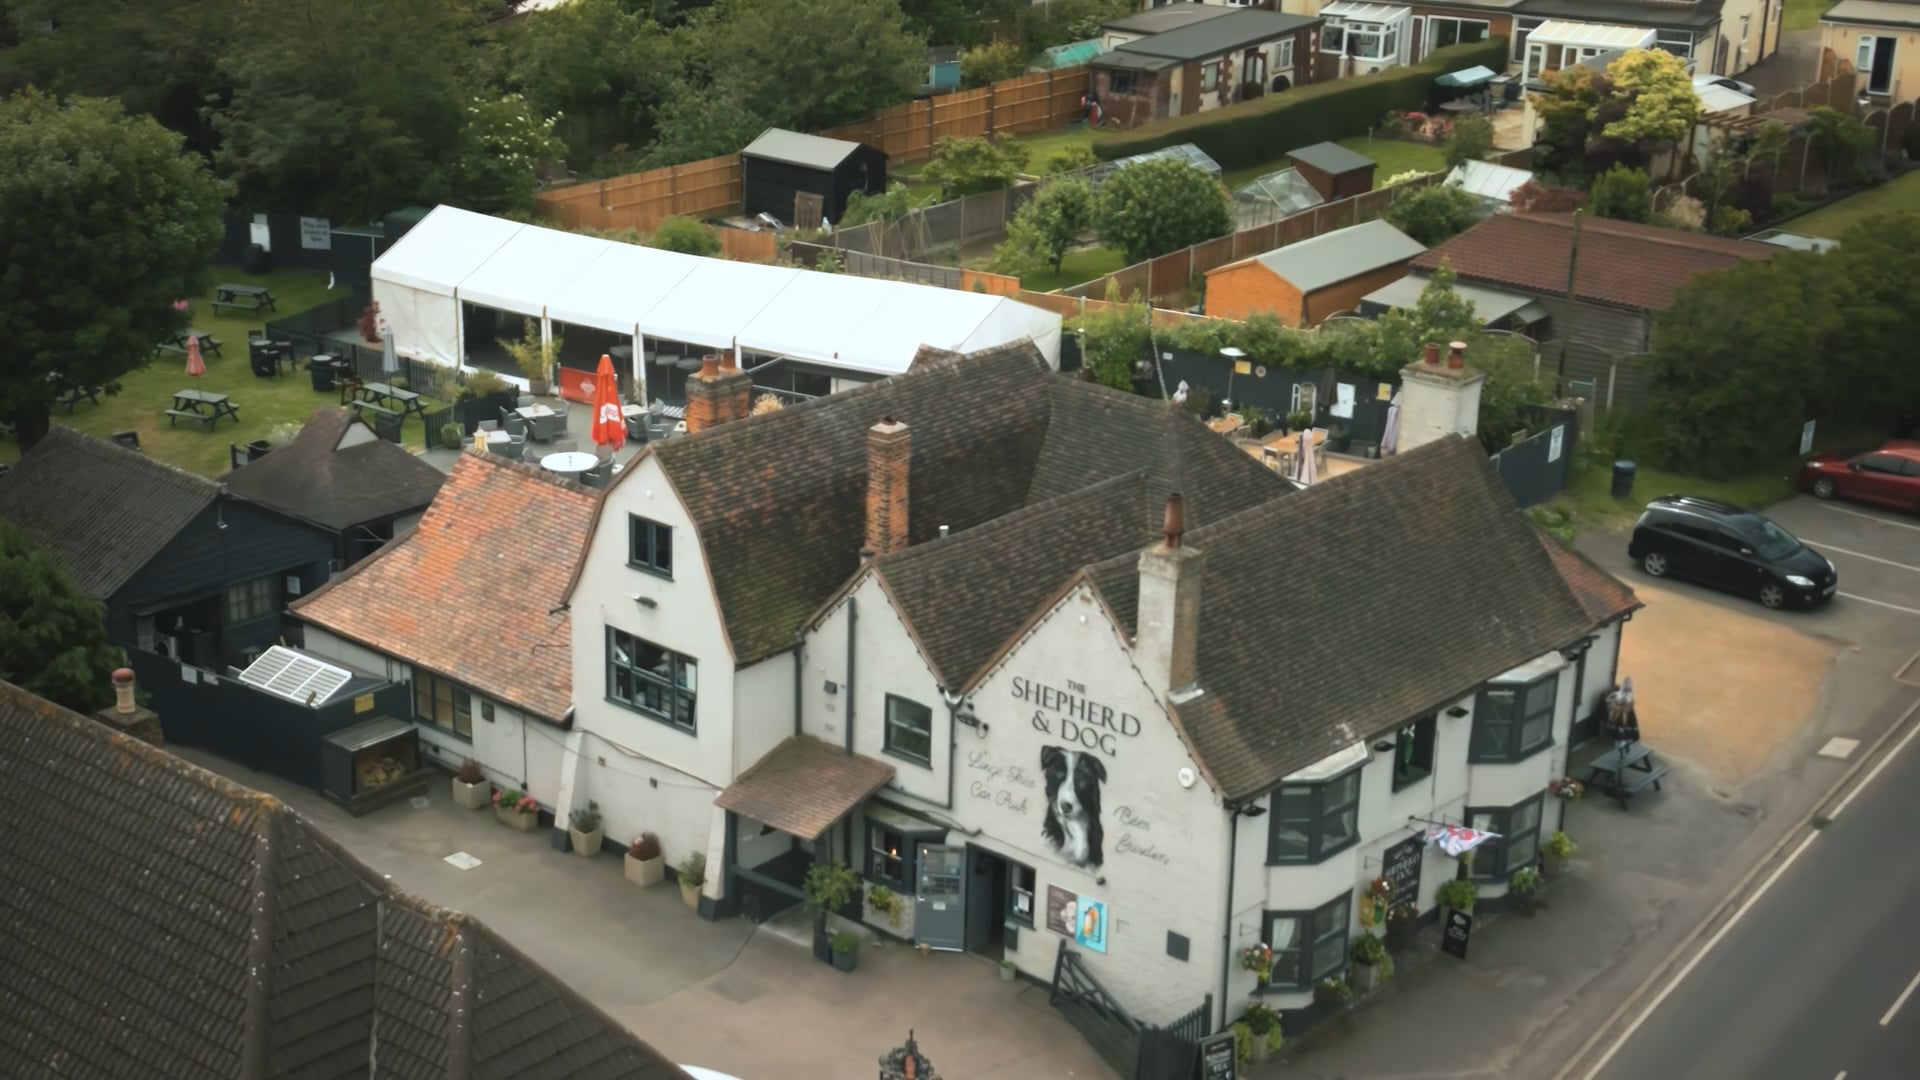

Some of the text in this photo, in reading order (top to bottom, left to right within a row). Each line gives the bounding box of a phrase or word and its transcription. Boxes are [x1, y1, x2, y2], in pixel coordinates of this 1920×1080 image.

[1011, 676, 1141, 738] SHEPHERD
[1067, 679, 1087, 694] THE
[1031, 710, 1117, 757] & DOG
